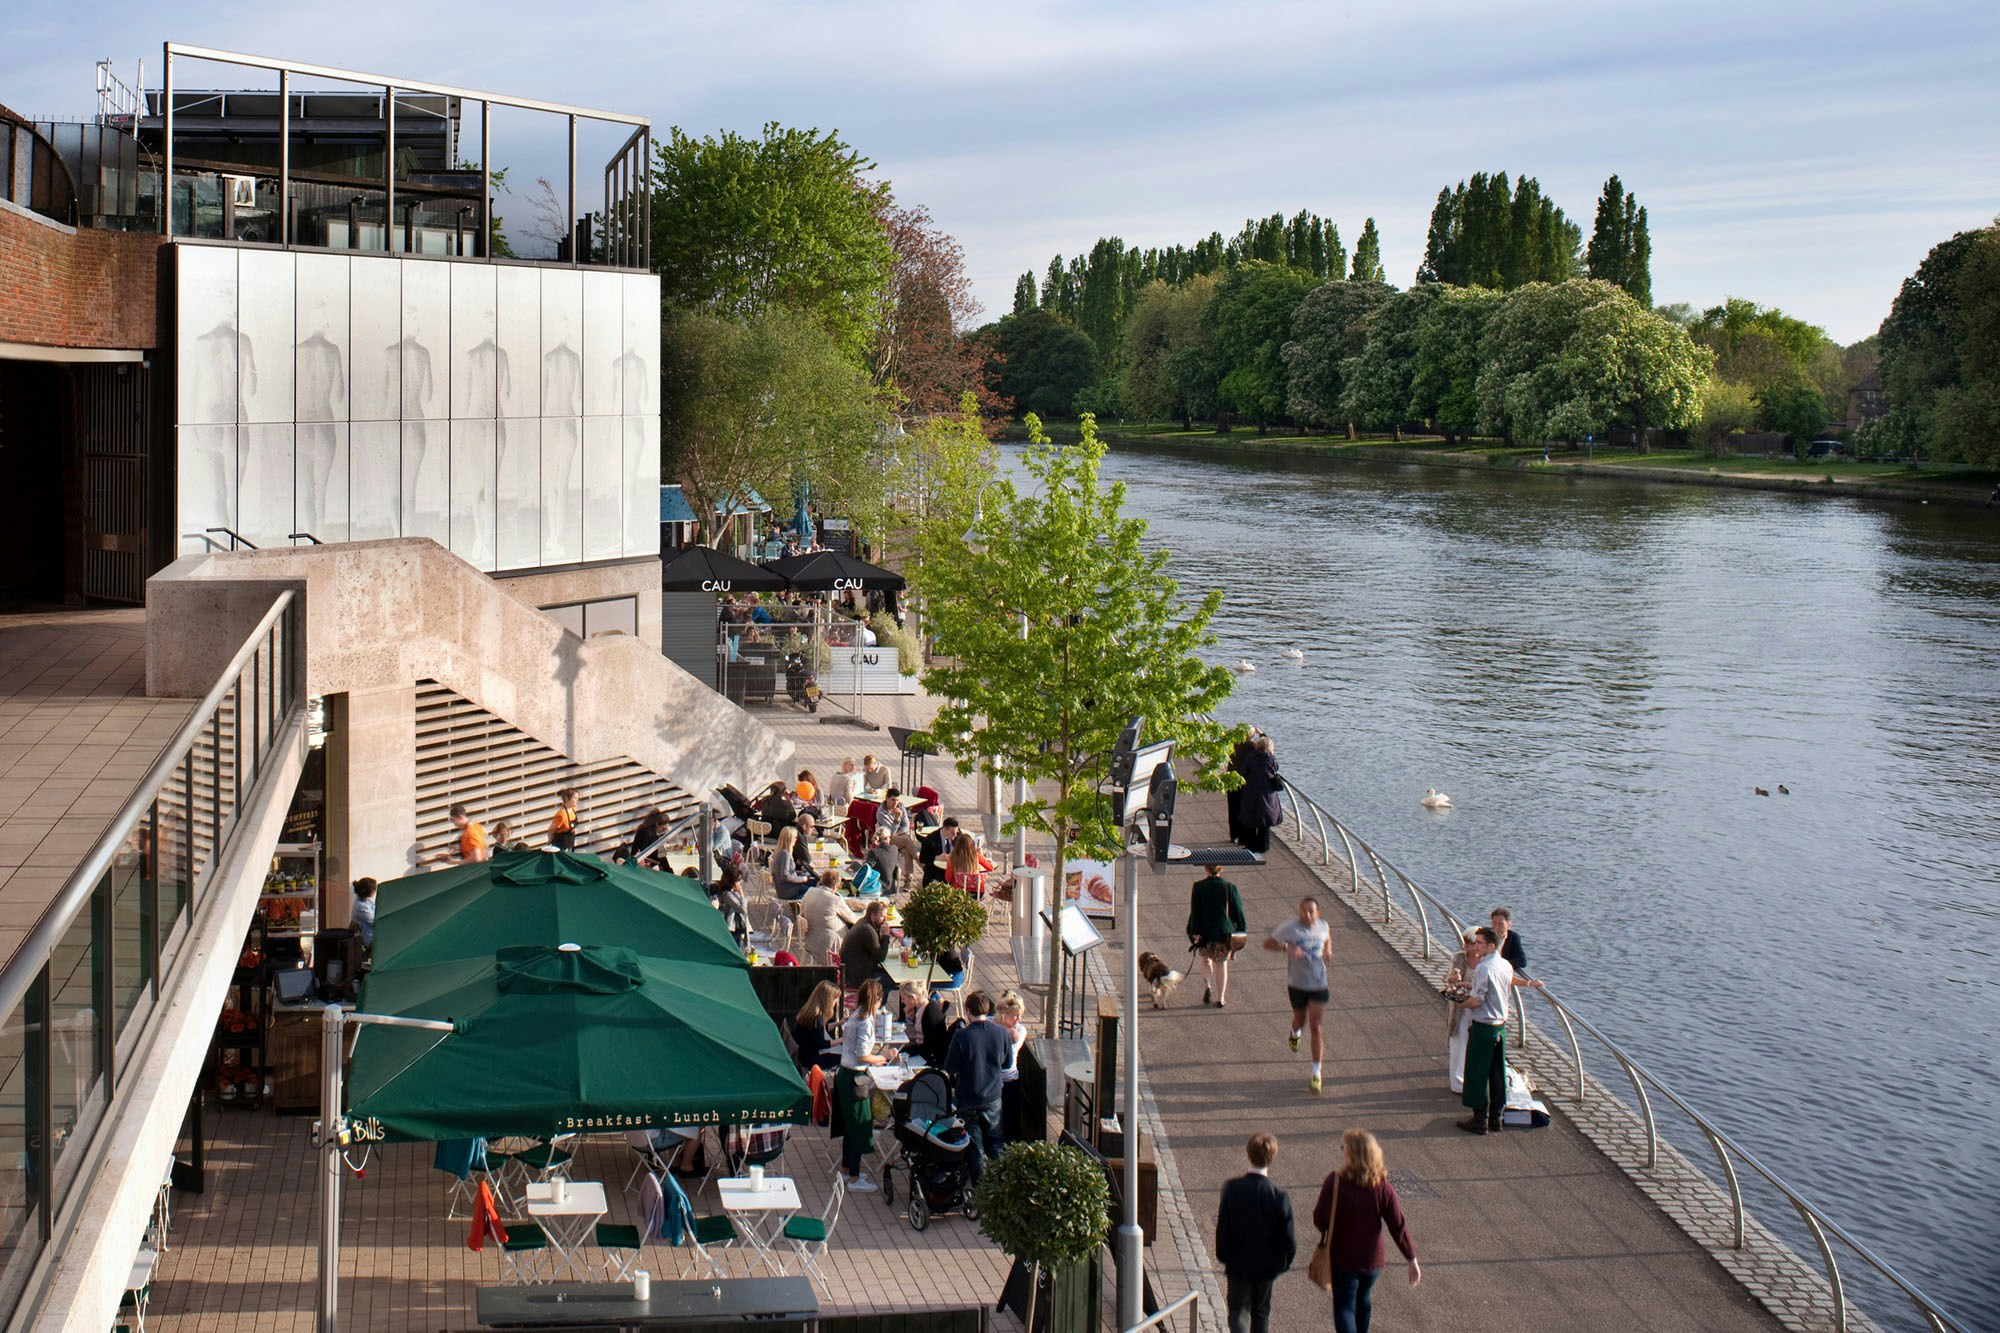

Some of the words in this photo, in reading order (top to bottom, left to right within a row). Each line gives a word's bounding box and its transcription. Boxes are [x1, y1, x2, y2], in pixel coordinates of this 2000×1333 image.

[702, 580, 731, 592] CAU
[834, 578, 863, 590] CAU
[566, 1113, 652, 1128] Breakfast
[674, 1110, 720, 1123] Lunch
[741, 1108, 794, 1120] Dinner
[352, 1116, 386, 1142] Bill's
